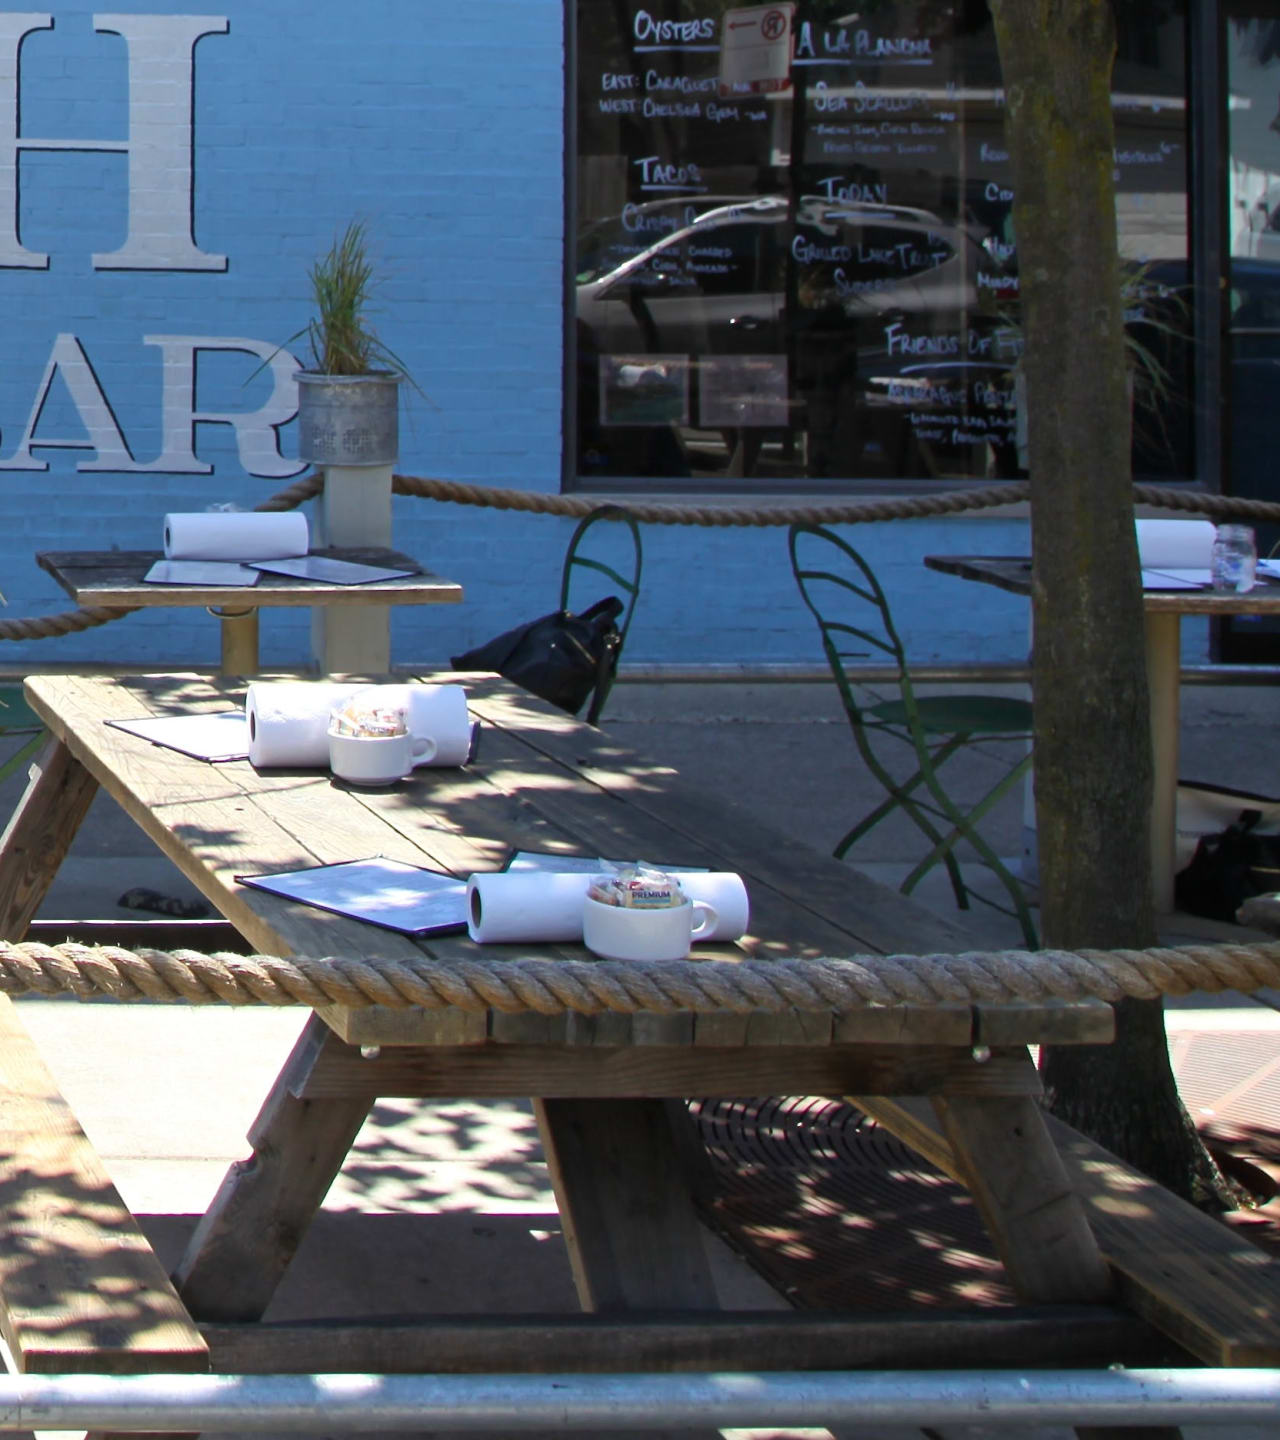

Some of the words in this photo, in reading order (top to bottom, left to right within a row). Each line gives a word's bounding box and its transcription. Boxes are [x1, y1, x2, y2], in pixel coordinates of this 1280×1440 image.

[633, 9, 715, 43] OYSTERS
[633, 156, 702, 184] TACOS
[817, 176, 888, 205] TODAY
[632, 890, 670, 899] PREMIUM
